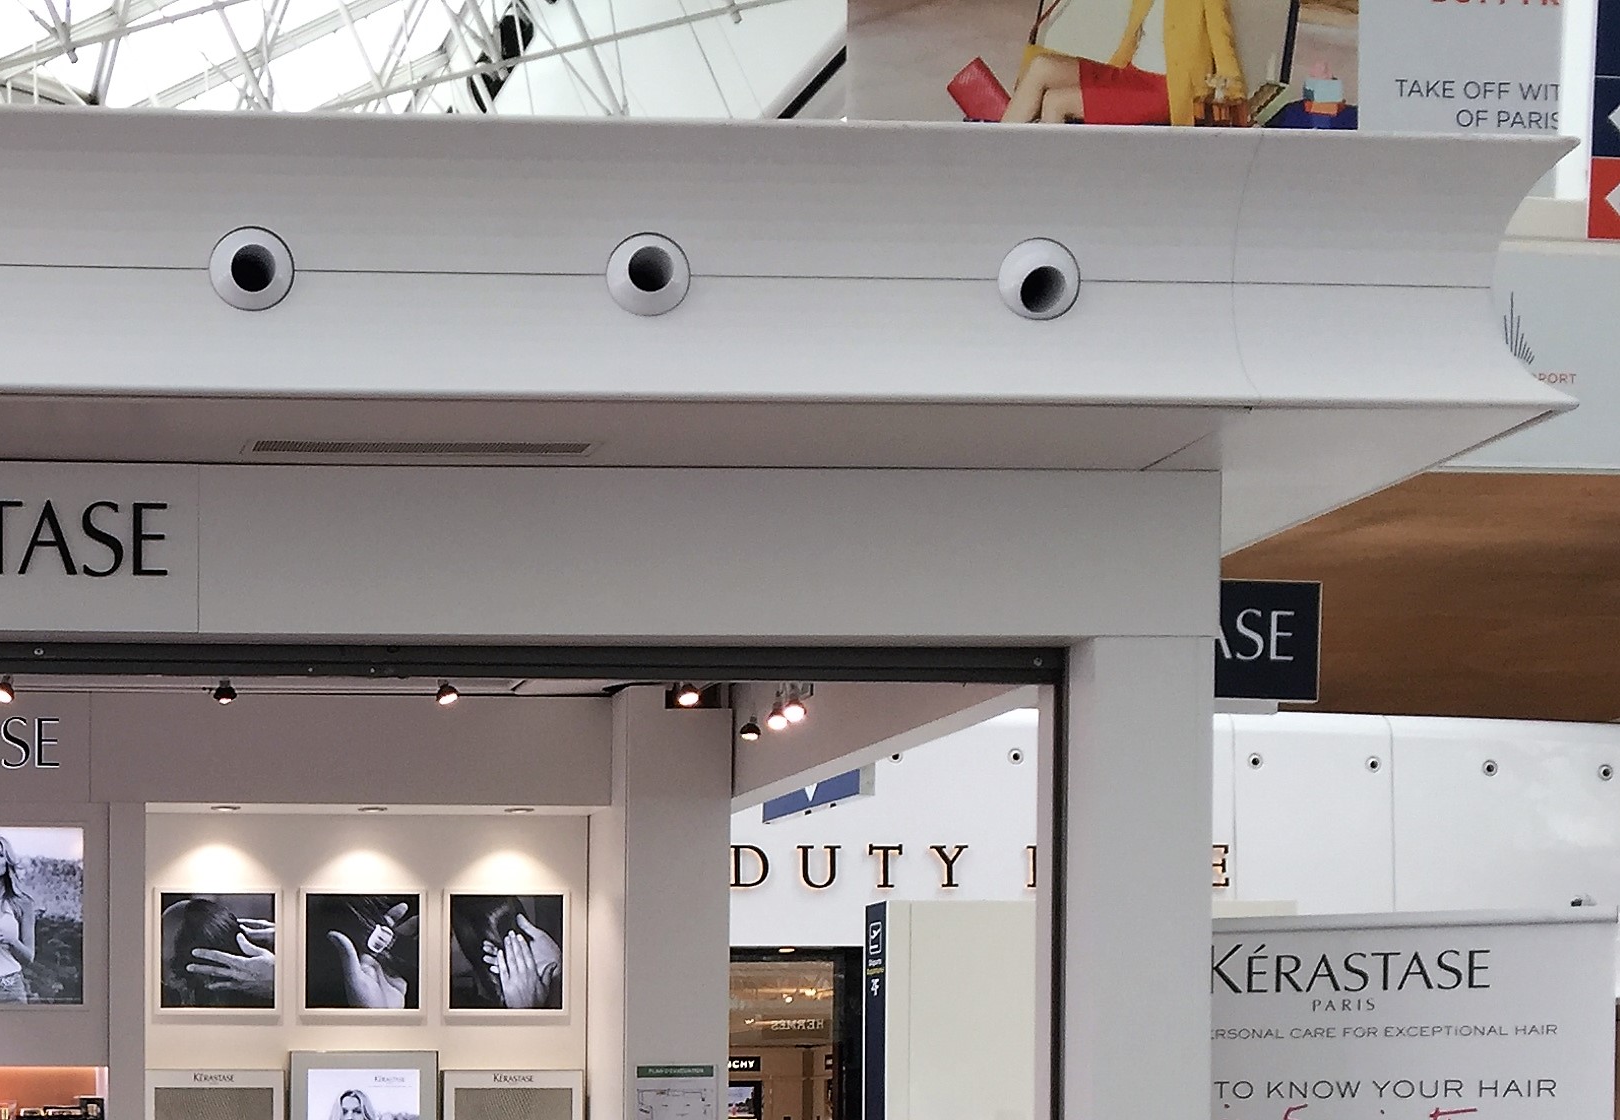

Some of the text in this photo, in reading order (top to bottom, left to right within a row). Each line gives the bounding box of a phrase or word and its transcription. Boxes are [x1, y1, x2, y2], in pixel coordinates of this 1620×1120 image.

[1395, 79, 1455, 99] TAKE
[1463, 81, 1511, 100] OFF
[1456, 109, 1488, 127] OF
[729, 844, 969, 889] DUTY
[1211, 942, 1491, 994] KÉRASTASE
[1312, 999, 1376, 1012] PARIS
[1290, 1027, 1336, 1039] CARE
[1343, 1026, 1379, 1039] FOR
[1384, 1025, 1508, 1038] EXCEPTIONAL
[1515, 1024, 1558, 1036] HAIR
[1214, 1079, 1558, 1100] TO KNOW YOUR HAIR
